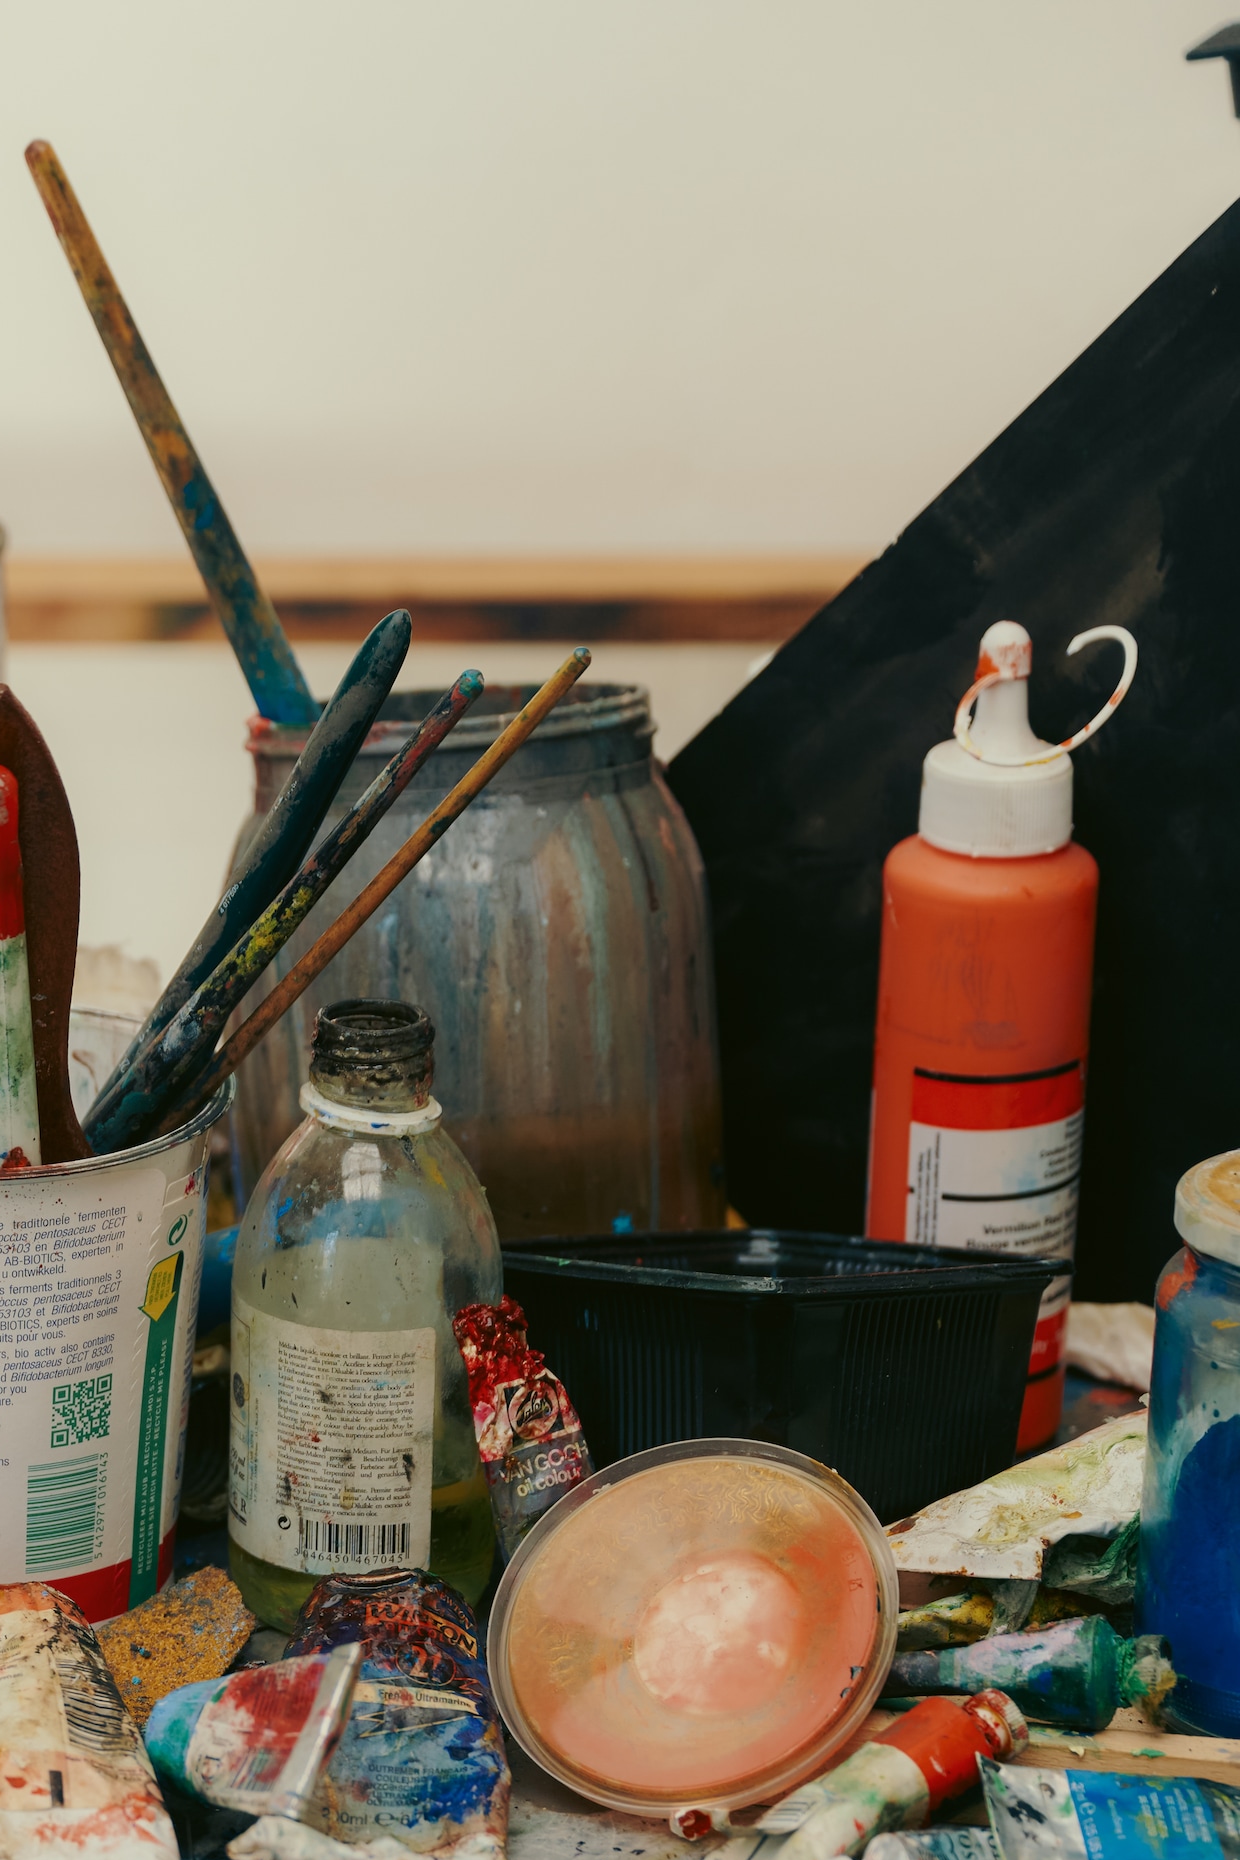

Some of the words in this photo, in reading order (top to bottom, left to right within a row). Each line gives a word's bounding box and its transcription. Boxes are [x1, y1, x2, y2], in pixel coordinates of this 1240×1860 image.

[13, 1216, 70, 1230] traditionele
[78, 1206, 126, 1222] fermenten
[34, 1224, 96, 1242] pentosaceus
[101, 1216, 127, 1231] CECT
[35, 1243, 47, 1252] en
[53, 1231, 125, 1251] Bifidobacterium
[4, 1252, 66, 1266] AB-BIOTICS,
[71, 1246, 111, 1261] experten
[116, 1243, 124, 1252] in
[9, 1283, 53, 1295] ferments
[57, 1272, 112, 1290] traditionnels
[116, 1270, 122, 1279] 3
[11, 1264, 67, 1278] ontwikkeld.
[46, 1315, 80, 1328] experts
[96, 1306, 118, 1318] soins
[34, 1346, 56, 1357] activ
[60, 1343, 78, 1354] also
[82, 1333, 115, 1349] contains
[158, 1338, 168, 1376] PLEASE
[157, 1378, 164, 1393] ME
[153, 1395, 163, 1440] RECYCLE
[143, 1394, 154, 1466] RECYCLEZ-MOI
[151, 1449, 159, 1477] BITTE
[141, 1476, 149, 1496] AUB
[149, 1479, 157, 1503] MICH
[516, 1477, 534, 1497] oil
[535, 1466, 582, 1491] colour
[137, 1518, 146, 1575] RECYCLEER
[146, 1522, 154, 1571] RECYCLEN
[356, 1553, 403, 1564] 467045
[415, 1692, 472, 1707] Ultramarine
